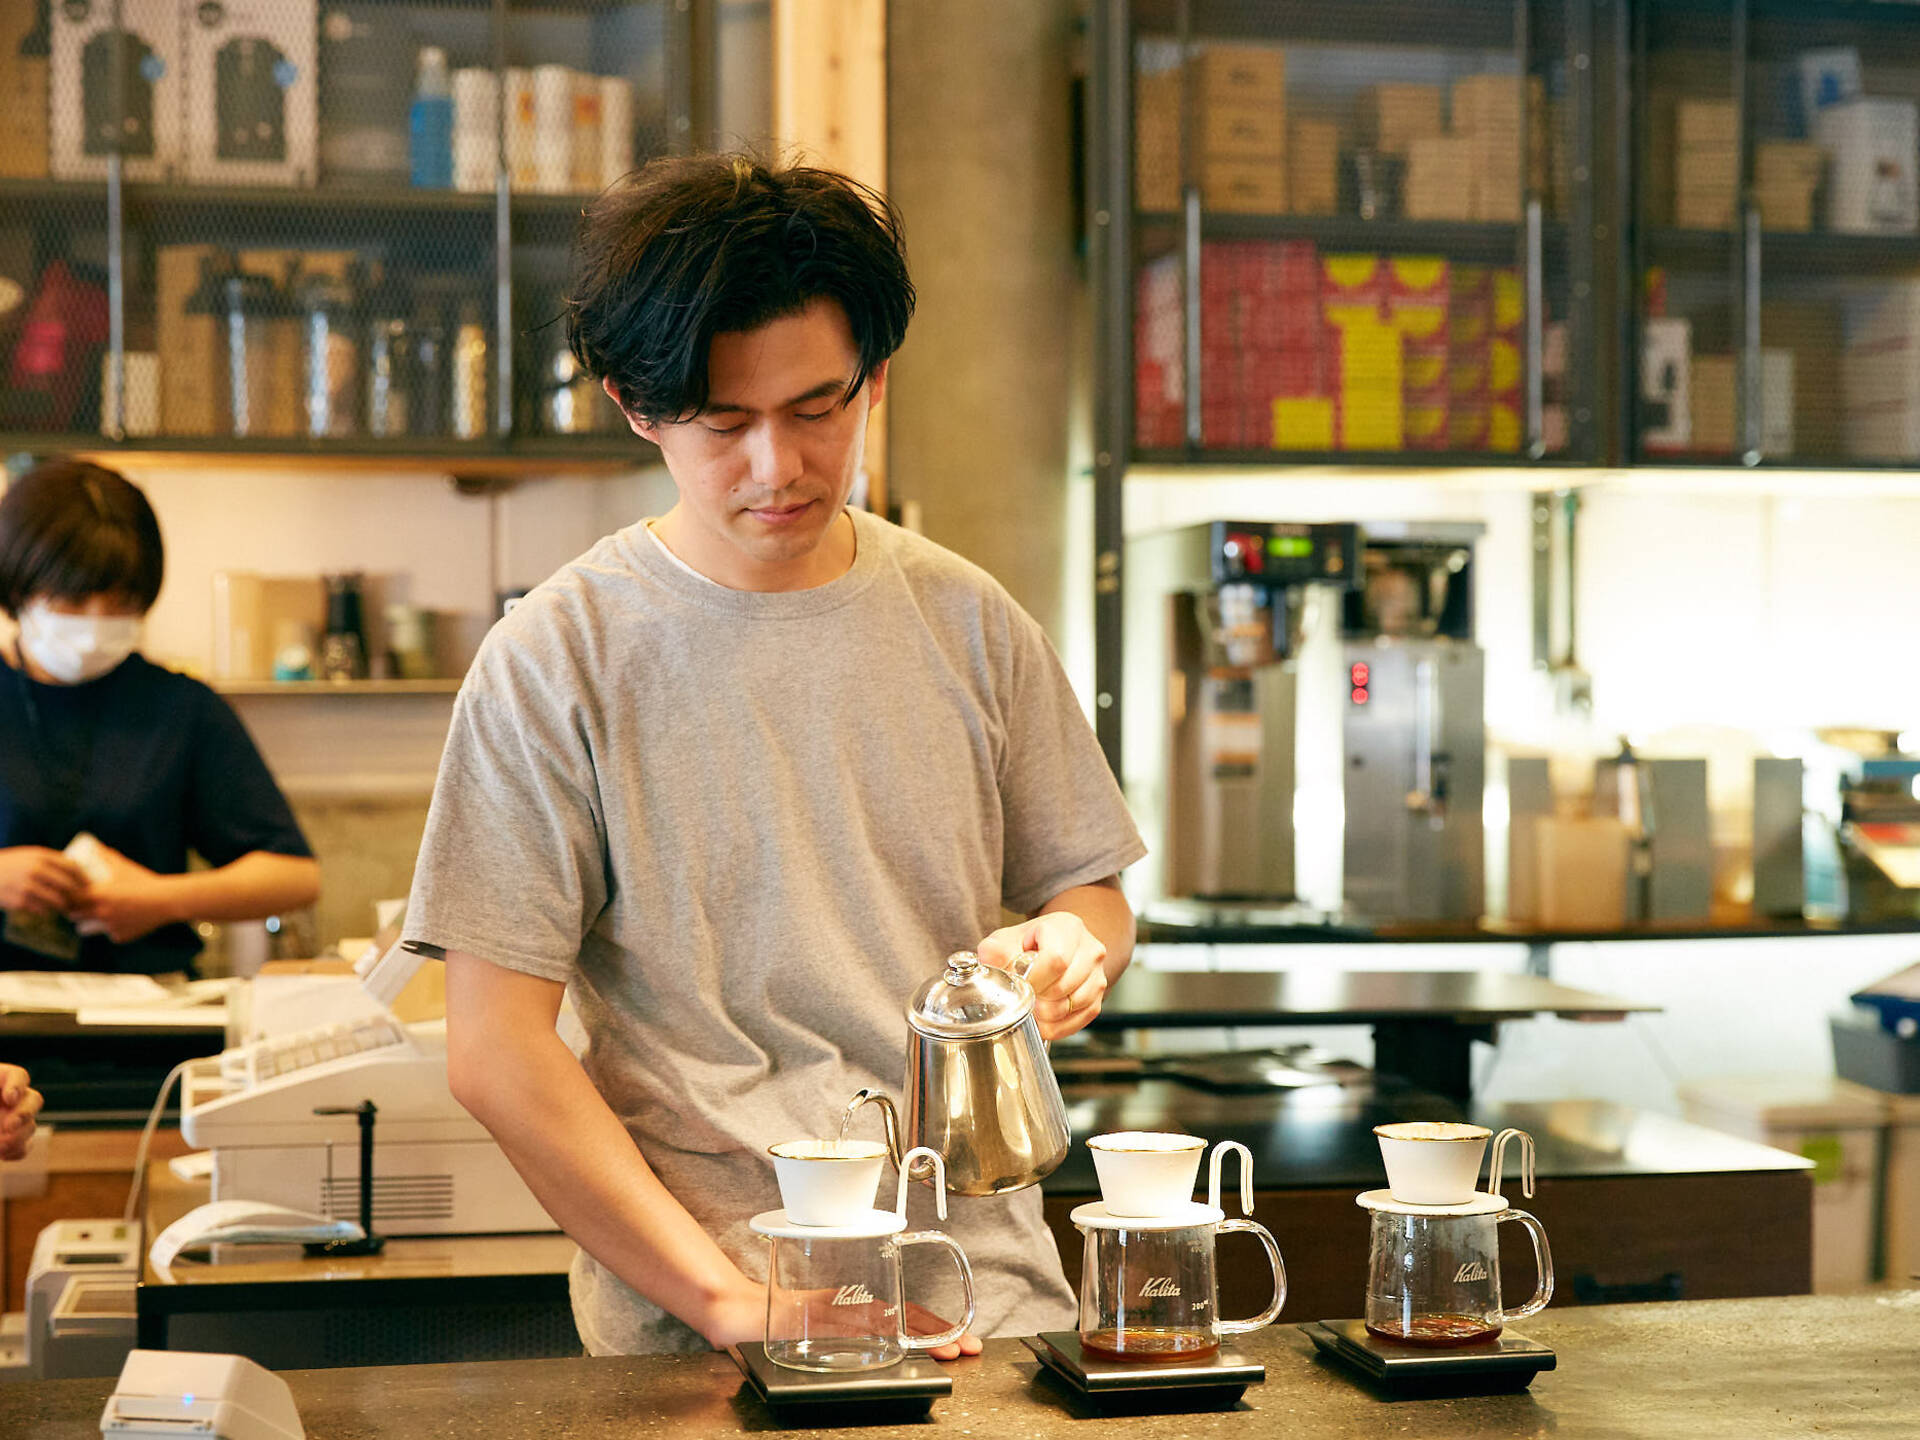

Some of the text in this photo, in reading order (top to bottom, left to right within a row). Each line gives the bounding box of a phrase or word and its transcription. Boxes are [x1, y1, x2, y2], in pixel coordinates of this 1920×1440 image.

[1453, 1261, 1488, 1283] Kalita
[832, 1284, 874, 1306] Kalita
[1139, 1277, 1181, 1297] Kalita
